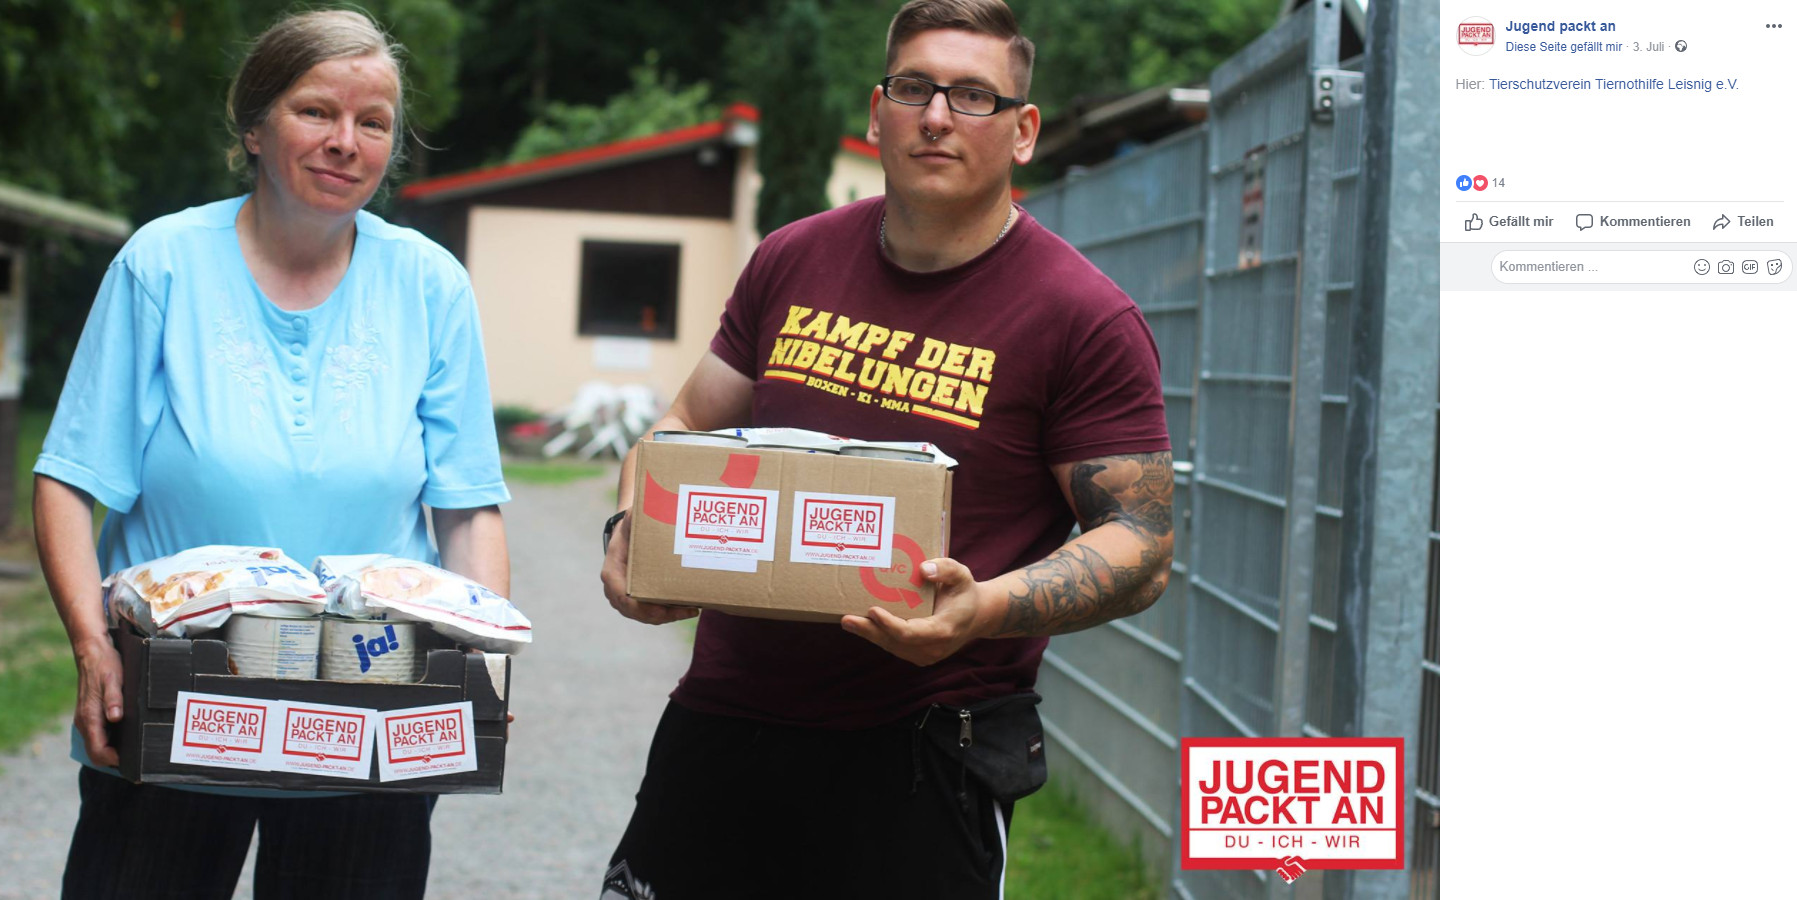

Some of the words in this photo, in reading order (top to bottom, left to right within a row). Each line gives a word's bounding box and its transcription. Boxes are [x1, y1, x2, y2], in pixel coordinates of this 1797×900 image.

[1505, 20, 1556, 35] Jugend
[1559, 20, 1597, 35] packt
[1599, 22, 1616, 32] an
[1505, 41, 1537, 52] Diese
[1539, 41, 1568, 52] Seite
[1570, 41, 1603, 55] gefällt
[1605, 41, 1623, 52] mir
[1632, 41, 1643, 52] 3.
[1645, 41, 1665, 52] Juli
[1455, 78, 1485, 90] Hier:
[1488, 78, 1591, 90] Tierschutzverein
[1594, 78, 1664, 90] Tiernothilfe
[1668, 78, 1713, 93] Leisnig
[1715, 78, 1739, 90] e.V.
[1492, 177, 1506, 188] 14
[1488, 215, 1531, 227] Gefällt
[1533, 215, 1555, 227] mir
[1599, 215, 1691, 227] Kommentieren
[1736, 215, 1774, 227] Teilen
[1499, 260, 1585, 272] Kommentieren
[1744, 262, 1757, 272] GIF
[779, 305, 916, 361] KAMPF
[914, 336, 997, 384] DER
[767, 337, 990, 418] NIBELUNGEN
[805, 376, 849, 398] BOXEN
[880, 397, 910, 413] MMA
[693, 500, 760, 516] JUGEND
[809, 507, 877, 523] JUGEND
[693, 512, 736, 525] PACKT
[739, 515, 759, 527] AN
[809, 520, 853, 532] PACKT
[856, 523, 875, 534] AN
[352, 624, 399, 674] ja!
[192, 707, 259, 726] JUGEND
[191, 720, 235, 735] PACKT
[238, 724, 258, 737] AN
[291, 716, 358, 734] JUGEND
[392, 717, 457, 738] JUGEND
[291, 729, 334, 743] PACKT
[337, 733, 356, 745] AN
[393, 733, 435, 747] PACKT
[439, 730, 458, 742] AN
